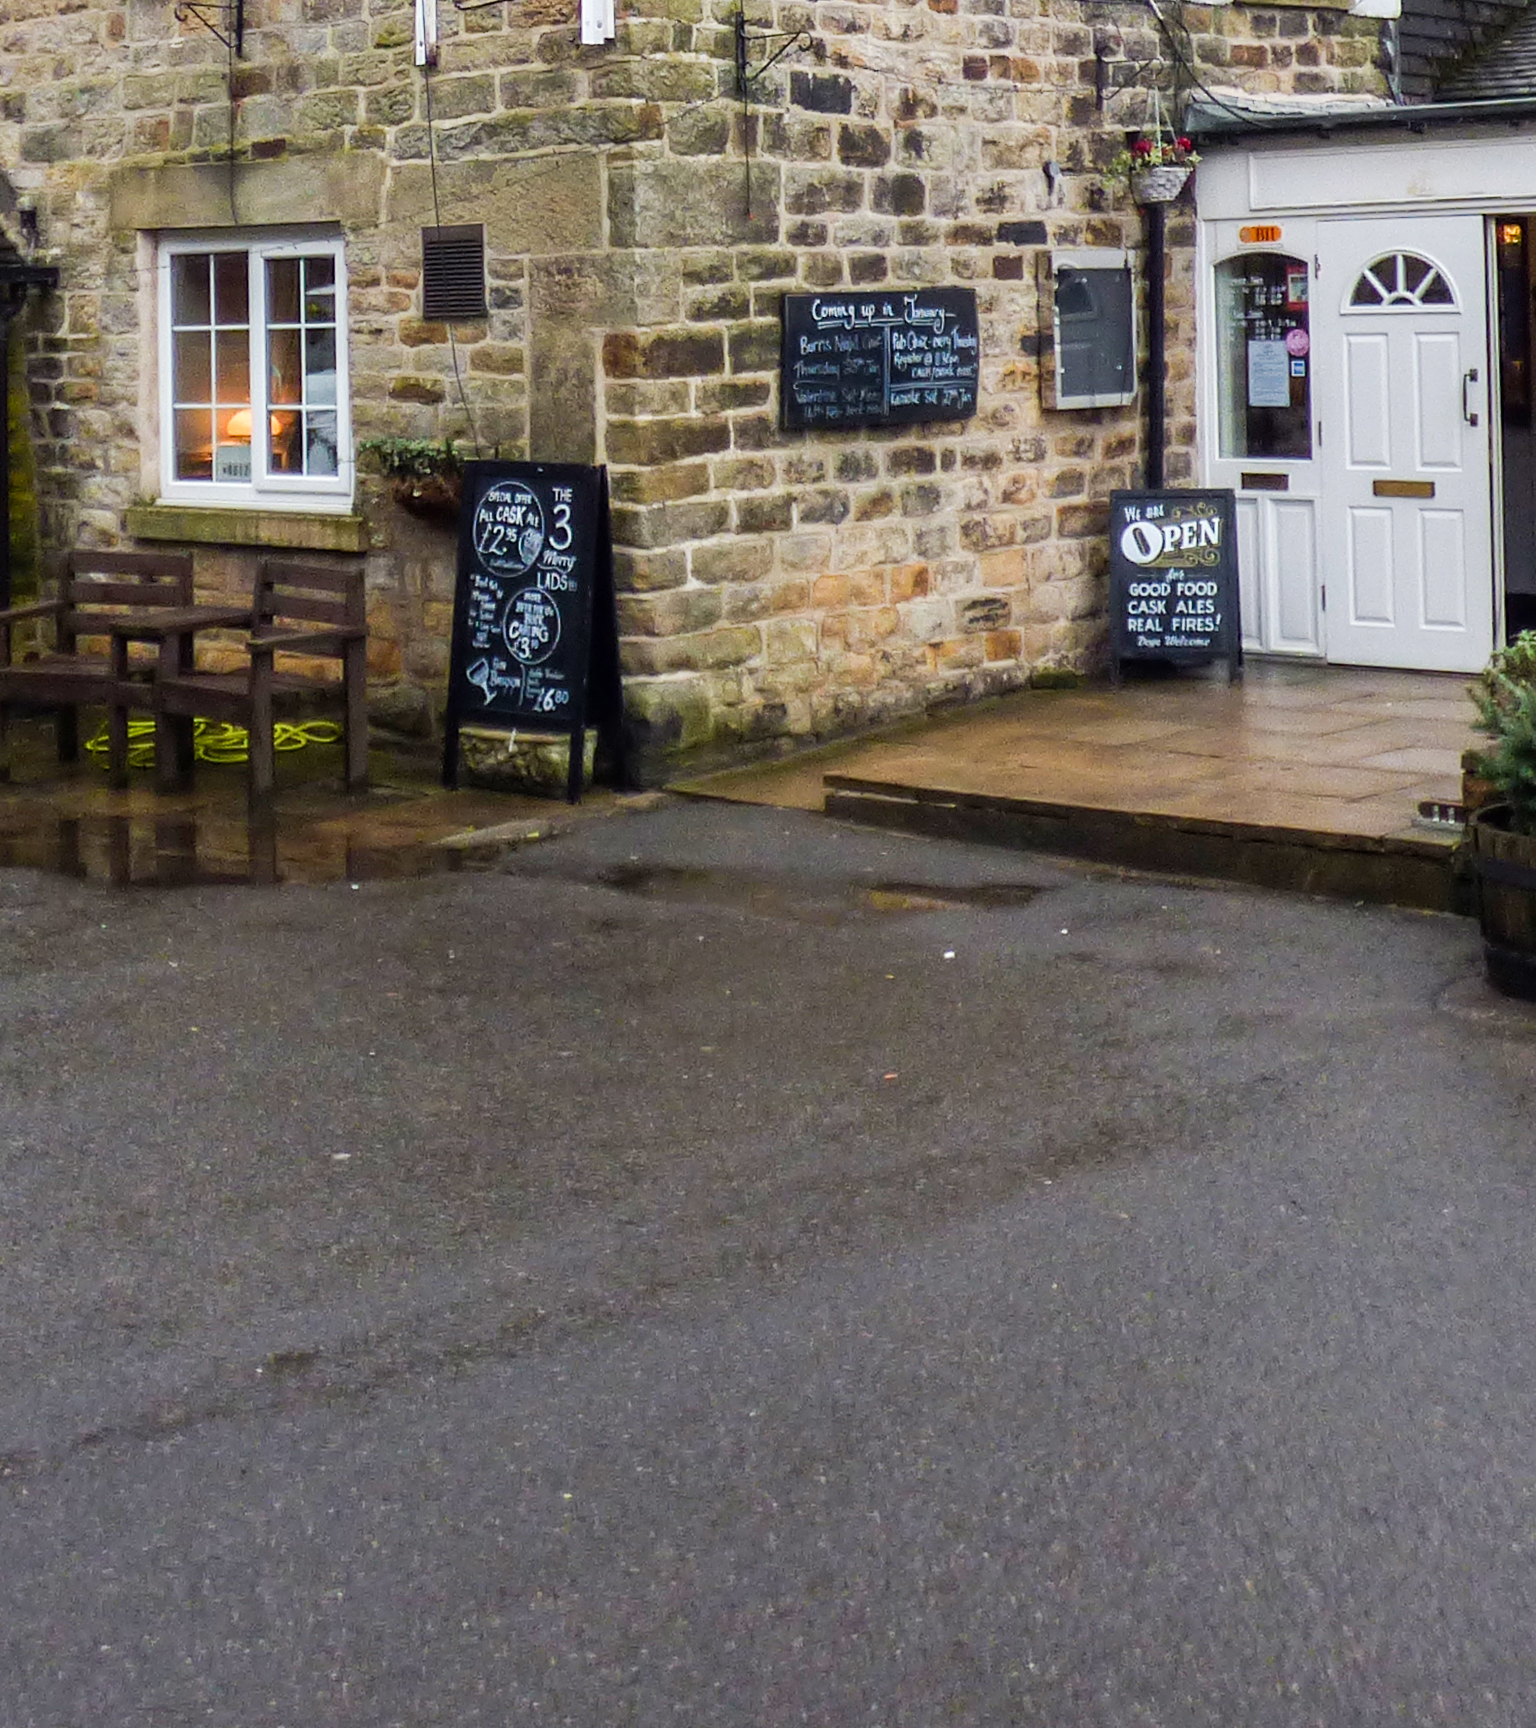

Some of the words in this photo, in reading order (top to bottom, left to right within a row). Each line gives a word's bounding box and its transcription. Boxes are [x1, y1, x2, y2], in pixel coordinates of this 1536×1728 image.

[812, 298, 855, 330] Coming
[861, 303, 875, 324] up
[883, 301, 895, 317] in
[904, 293, 946, 335] January
[552, 486, 574, 503] THE
[496, 504, 527, 527] CASK
[549, 503, 573, 551] 3
[1121, 516, 1221, 565] OPEN
[537, 571, 569, 591] LADS
[1128, 581, 1171, 597] GOOD
[1176, 581, 1219, 597] FOOD
[1128, 599, 1167, 615] CASK
[1175, 599, 1216, 614] ALES
[1127, 617, 1164, 632] REAL
[1171, 612, 1223, 632] FIRES!
